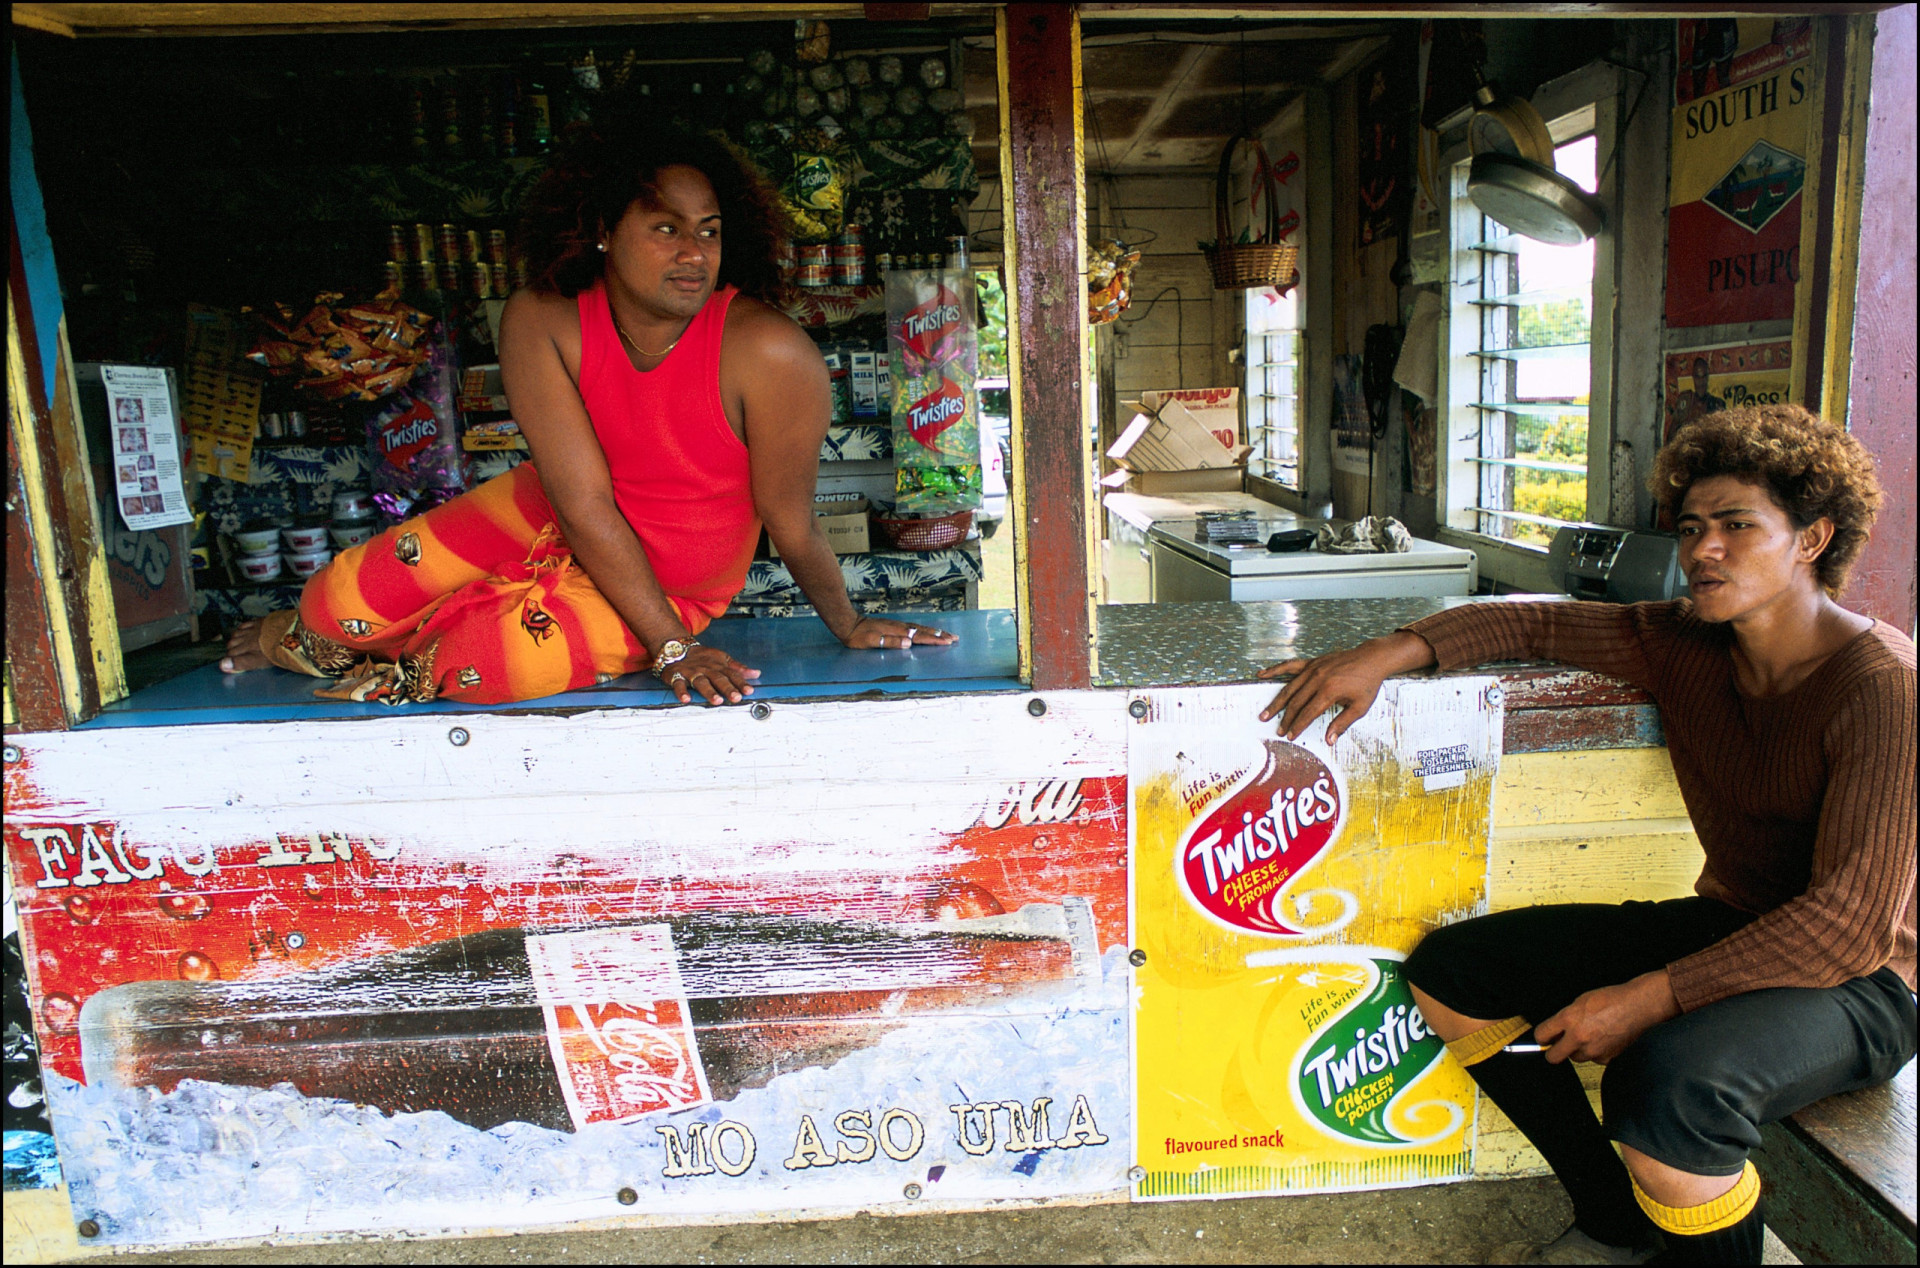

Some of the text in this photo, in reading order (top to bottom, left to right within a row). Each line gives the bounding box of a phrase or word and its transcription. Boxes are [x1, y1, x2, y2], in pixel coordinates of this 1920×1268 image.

[1686, 66, 1805, 139] SOUTH S
[905, 304, 960, 340] Twisties
[853, 371, 874, 379] MILK
[909, 396, 964, 431] Twisties
[382, 419, 437, 453] Twisties
[1182, 770, 1222, 804] Life is
[1413, 768, 1430, 777] THE
[1189, 791, 1212, 818] Fun
[1188, 777, 1337, 896] Twisties
[1223, 860, 1279, 907] CHEESE
[1238, 867, 1290, 912] FROMAGE
[1300, 989, 1337, 1021] Life is
[1307, 1010, 1329, 1034] Fun
[656, 1093, 1109, 1179] MO ASO UMA
[1164, 1129, 1285, 1155] flavoured snack
